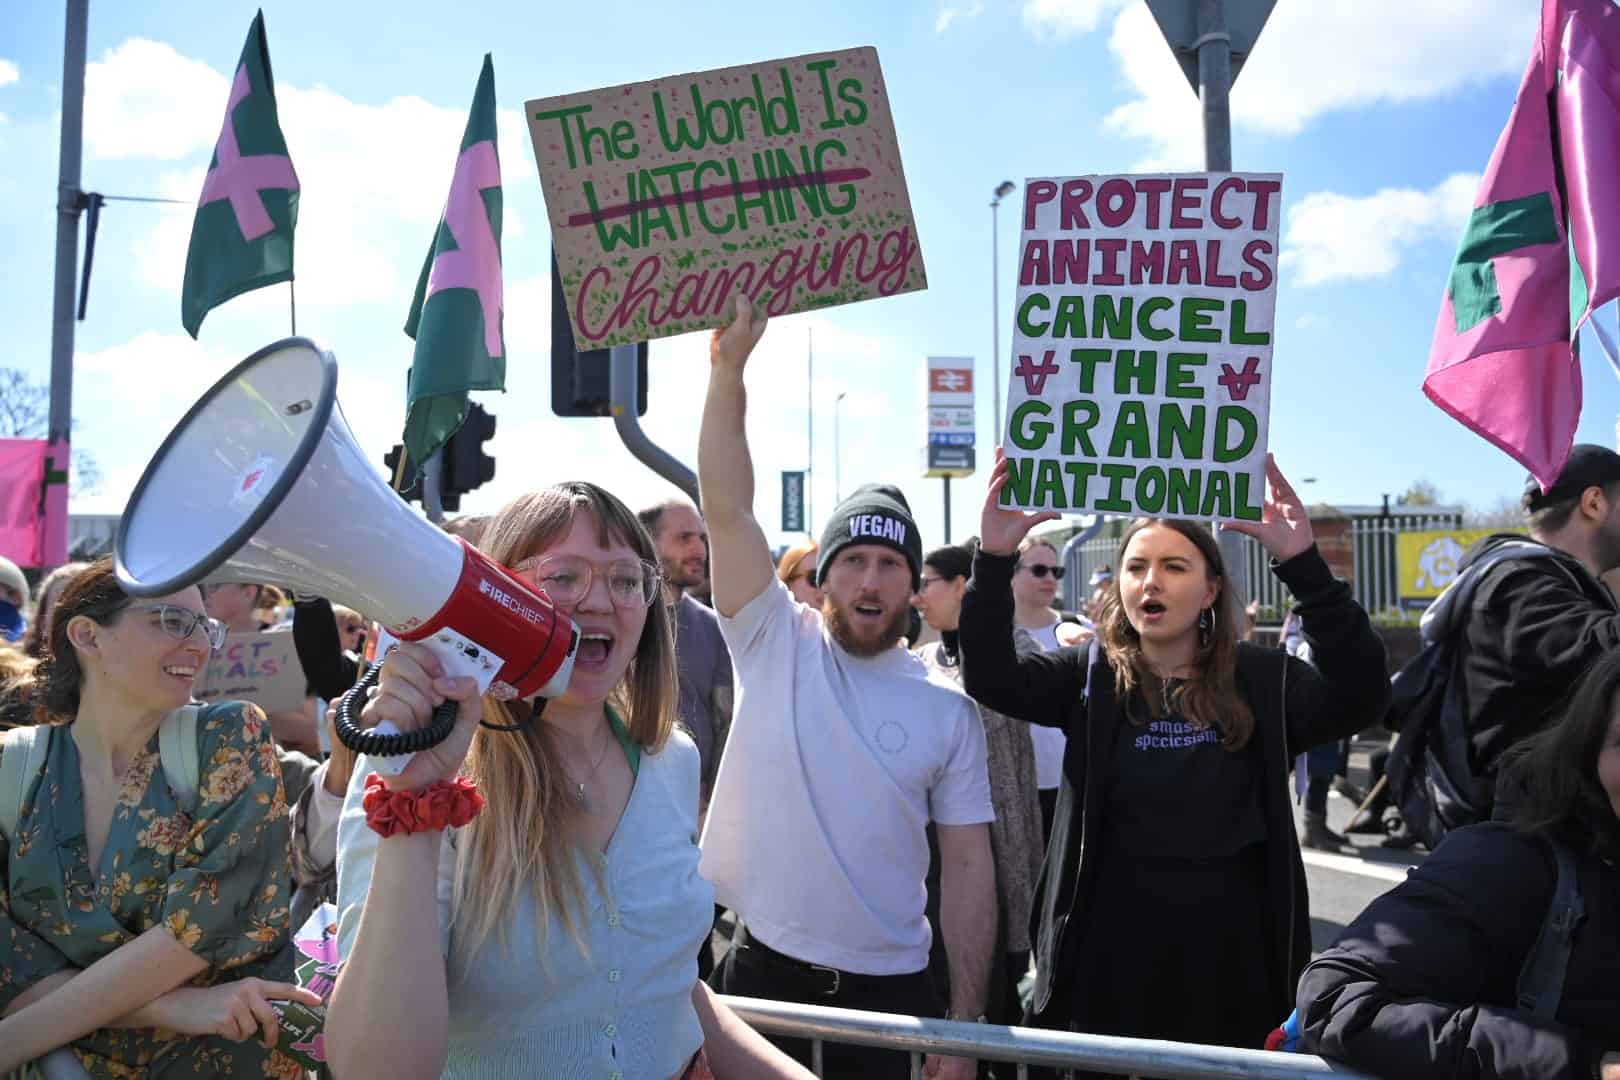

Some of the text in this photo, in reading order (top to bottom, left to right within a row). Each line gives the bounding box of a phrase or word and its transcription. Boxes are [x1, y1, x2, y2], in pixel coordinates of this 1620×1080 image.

[535, 59, 869, 169] The World Is
[582, 139, 858, 252] WATCHING
[1024, 177, 1281, 231] PROTECT
[576, 225, 918, 341] Changing
[1019, 238, 1274, 291] ANIMALS
[1016, 293, 1271, 346] CANCEL
[1070, 348, 1208, 399] THE
[1009, 400, 1259, 463] GRAND
[1001, 457, 1263, 522] NATIONAL
[850, 514, 907, 545] VEGAN
[479, 579, 543, 624] FIRECHIEF
[1149, 720, 1198, 734] smas
